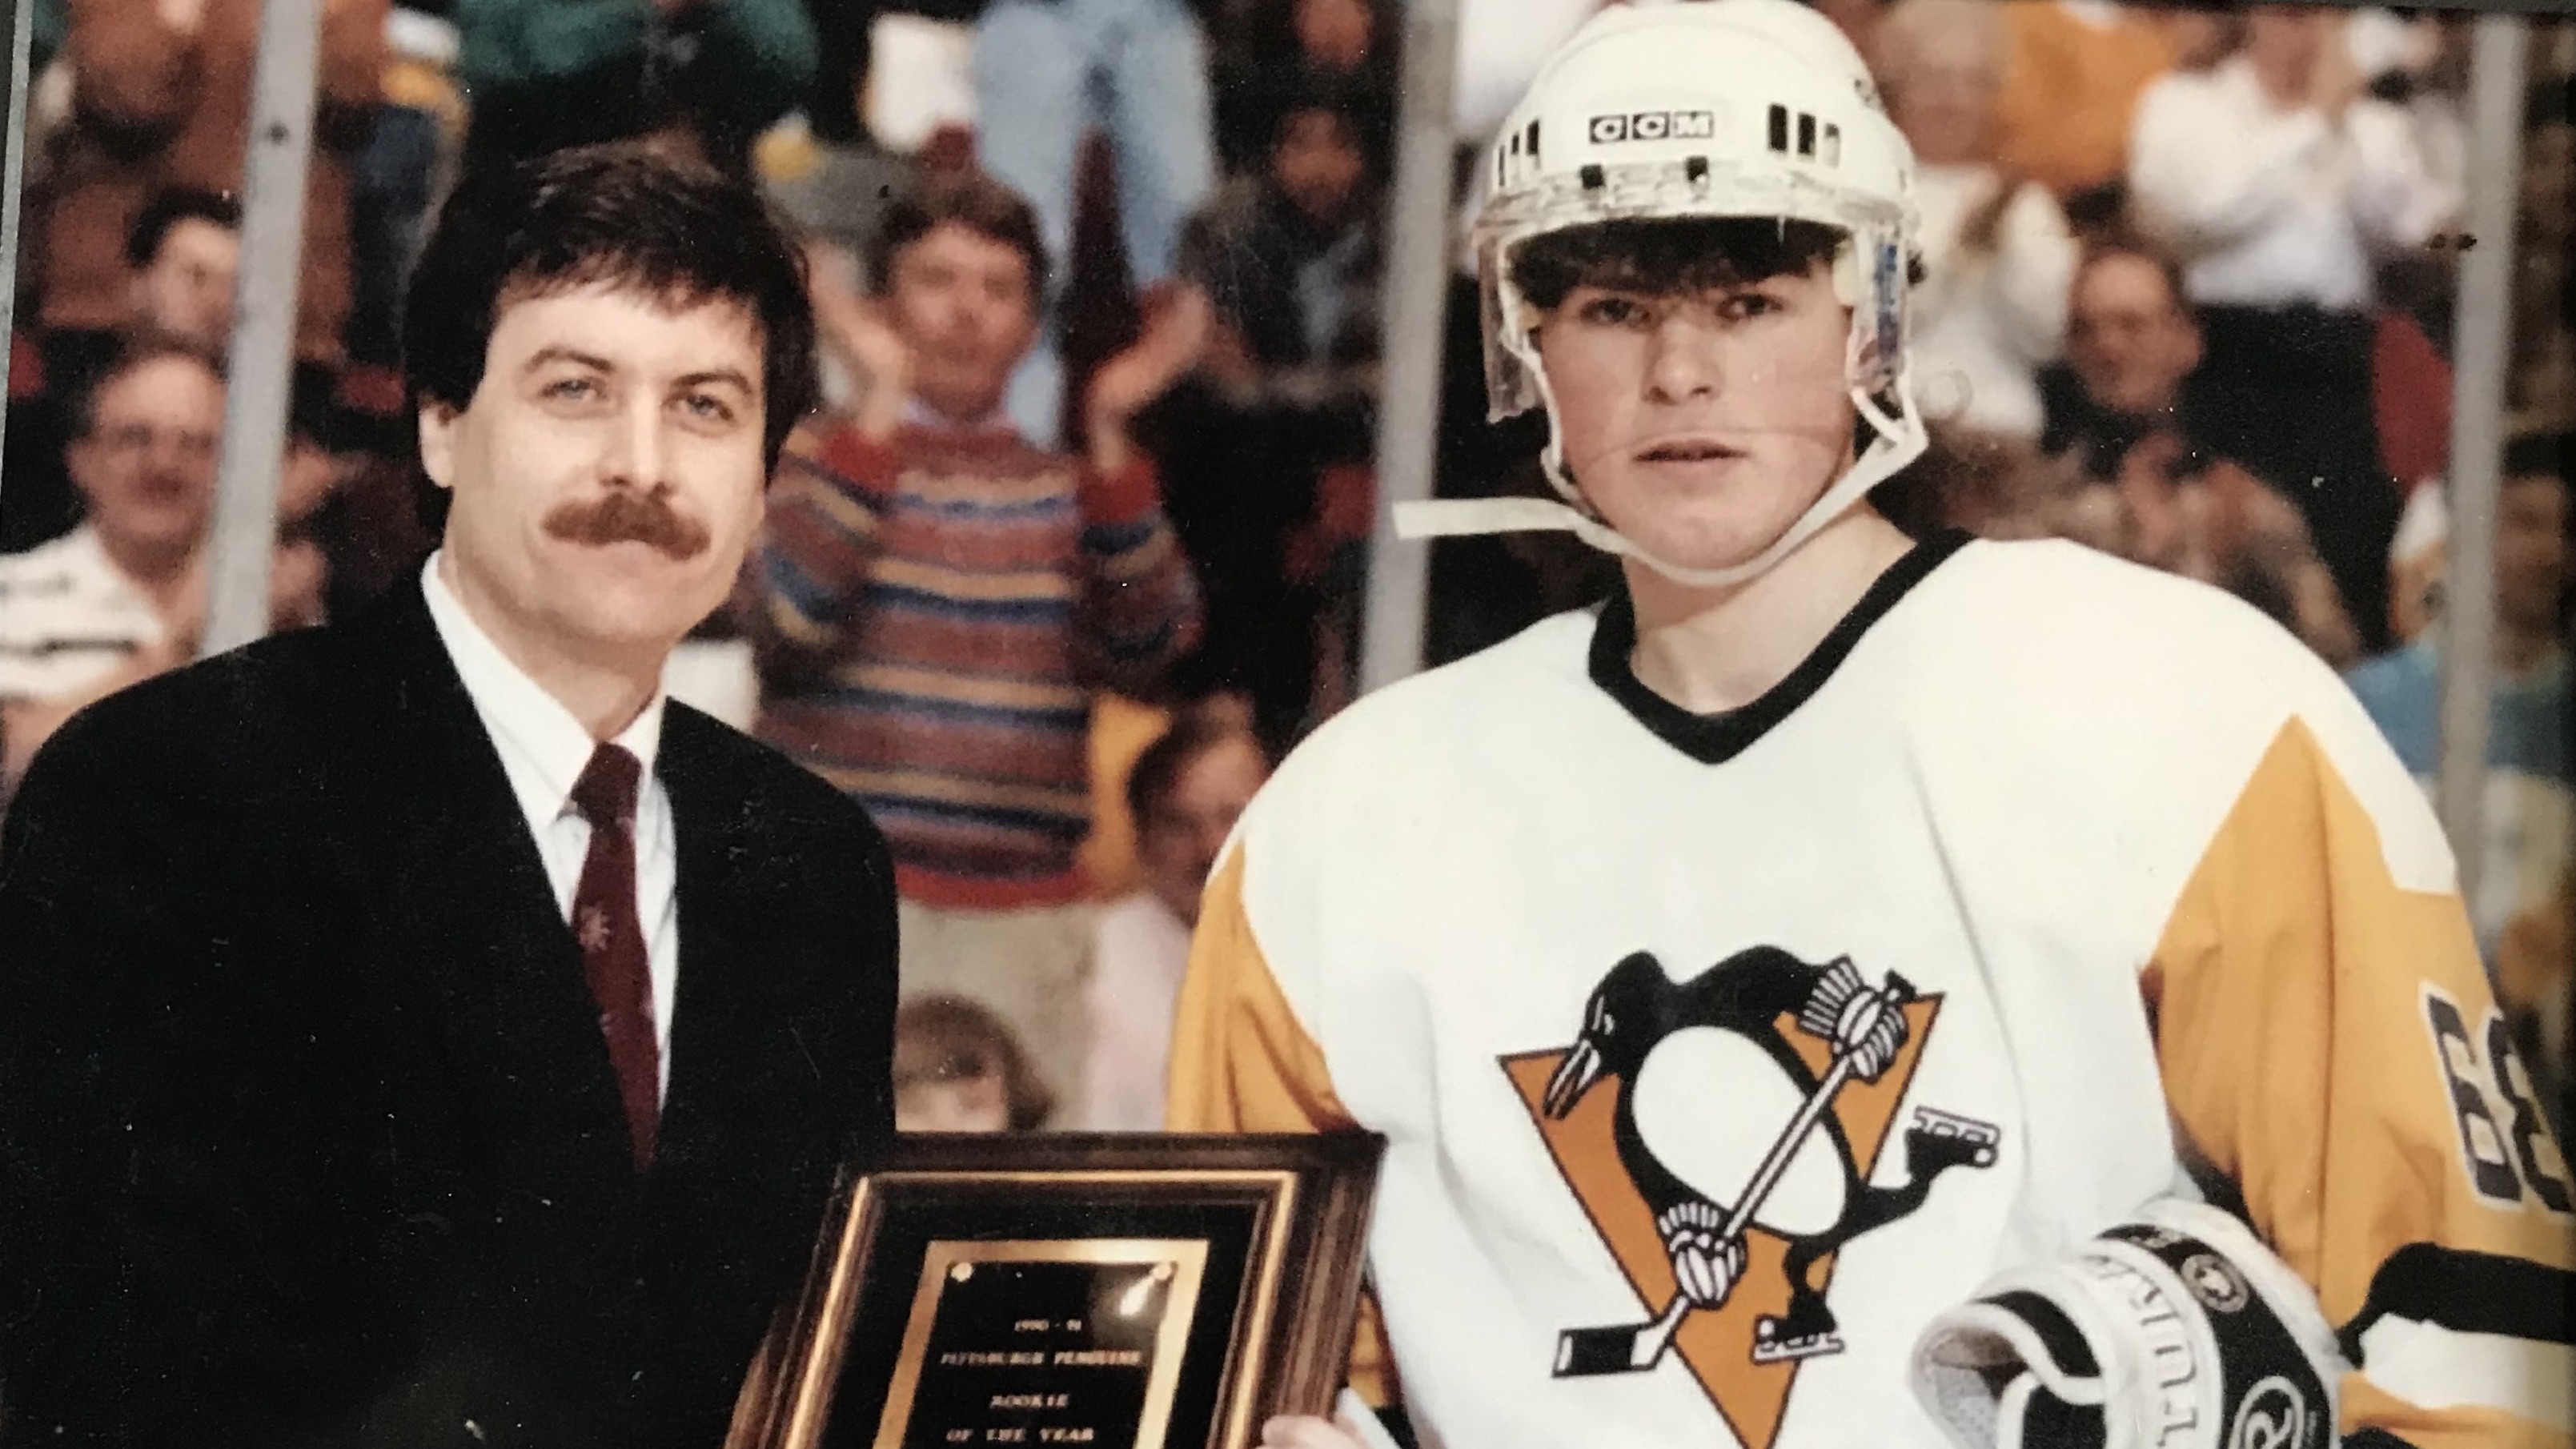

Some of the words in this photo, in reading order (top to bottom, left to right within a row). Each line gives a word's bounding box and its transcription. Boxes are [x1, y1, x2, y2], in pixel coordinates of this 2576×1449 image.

[1589, 111, 1714, 144] CCM
[2421, 983, 2574, 1215] 68
[990, 1393, 1069, 1409] ROOKIE
[945, 1427, 973, 1443] OF
[985, 1427, 1025, 1443] THE
[1040, 1427, 1094, 1443] YEAR
